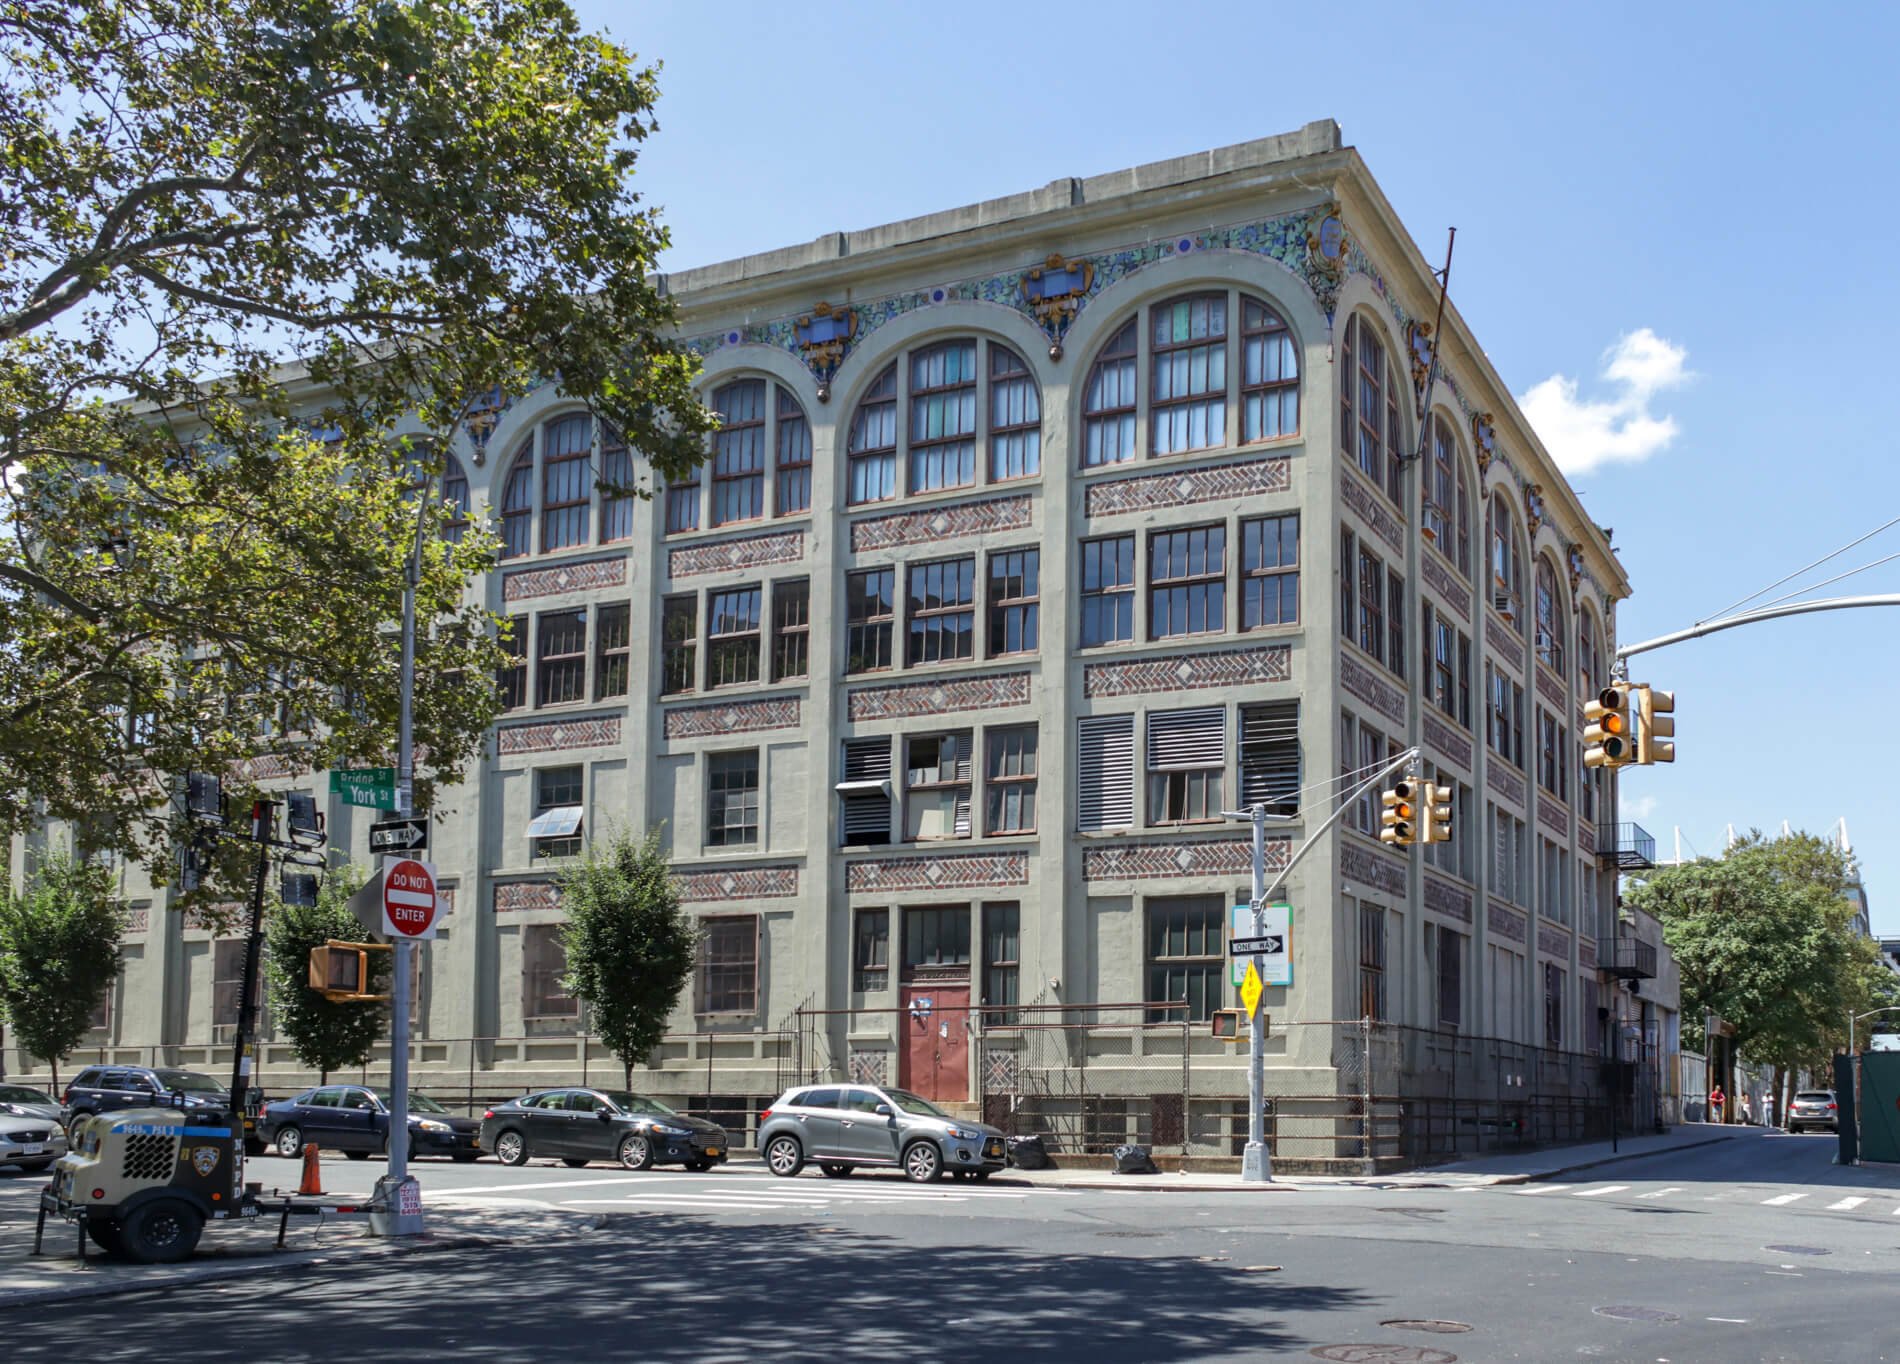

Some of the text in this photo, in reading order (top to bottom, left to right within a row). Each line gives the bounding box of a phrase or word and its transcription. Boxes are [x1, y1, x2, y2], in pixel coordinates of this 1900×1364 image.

[341, 770, 386, 785] Bridge St
[351, 785, 389, 806] York St
[375, 828, 416, 844] ONE WAY
[393, 873, 428, 889] DO NOT
[395, 907, 425, 922] ENTER
[1236, 941, 1274, 952] ONE WAY
[234, 1138, 243, 1199] NYPD
